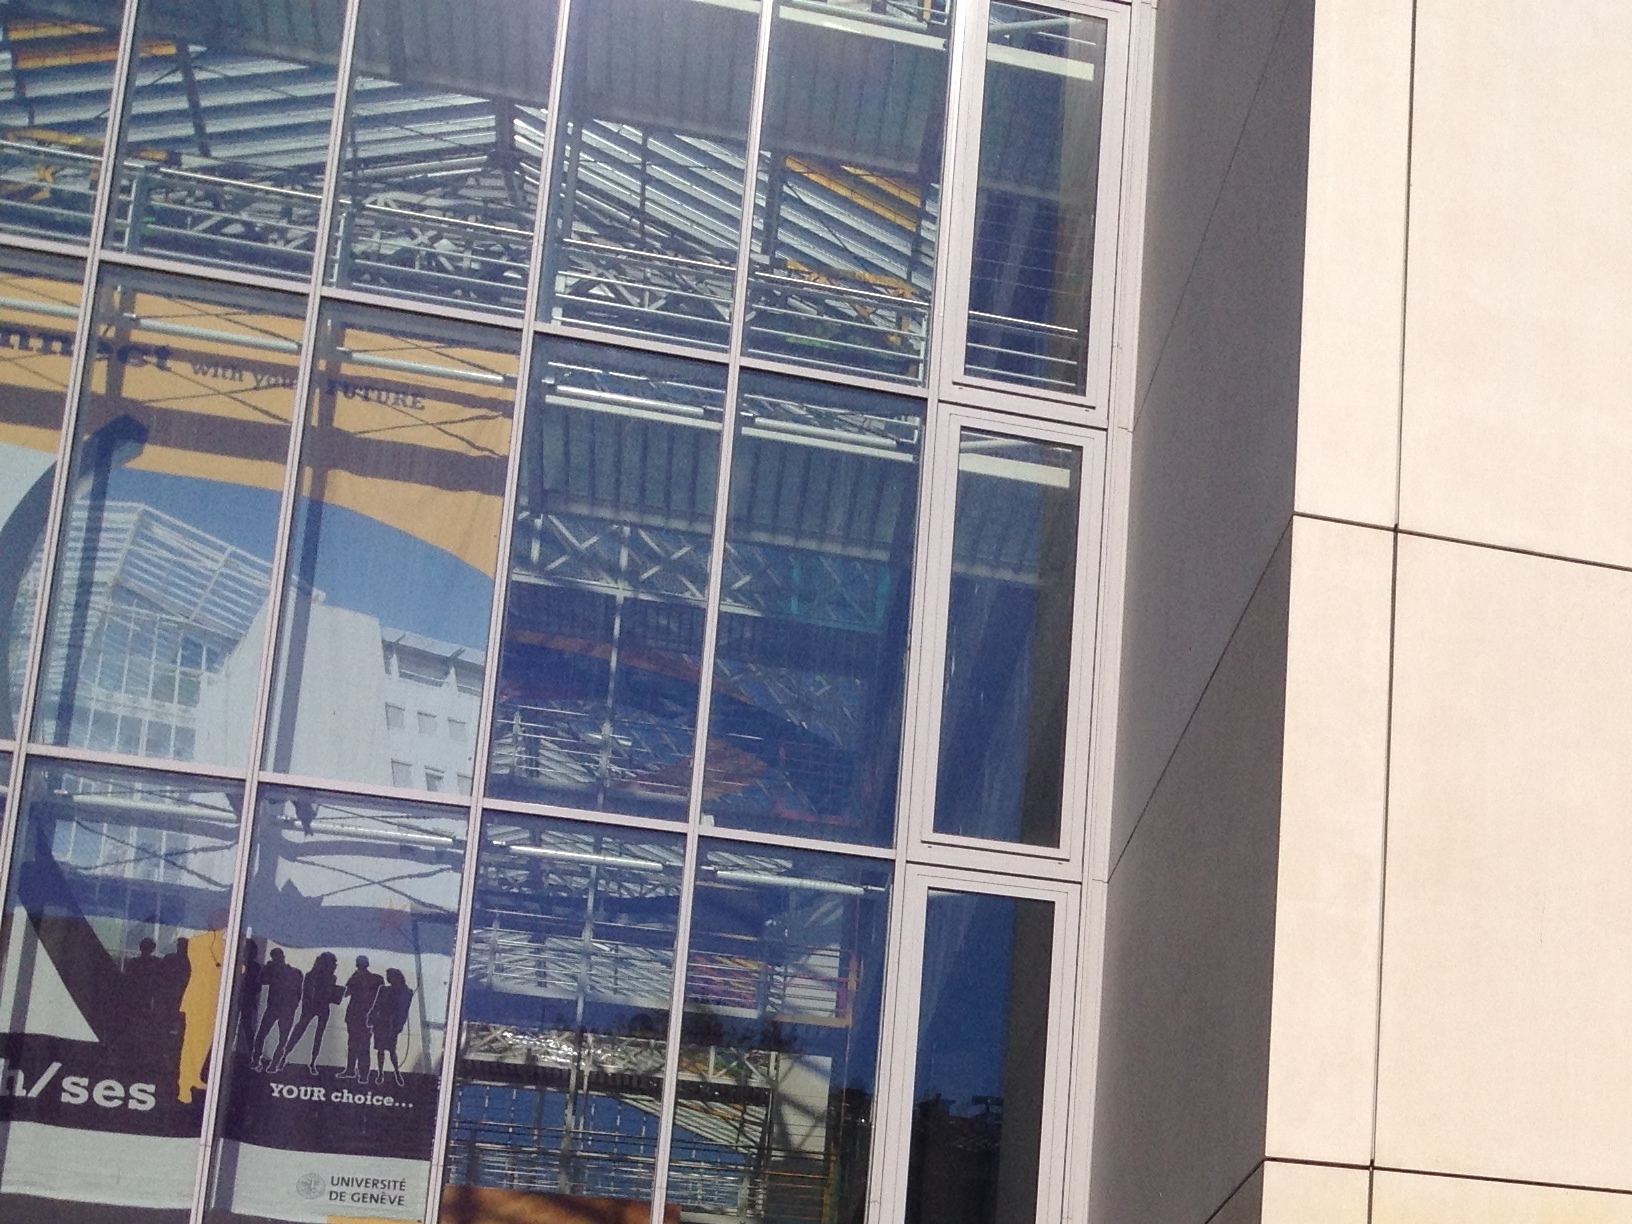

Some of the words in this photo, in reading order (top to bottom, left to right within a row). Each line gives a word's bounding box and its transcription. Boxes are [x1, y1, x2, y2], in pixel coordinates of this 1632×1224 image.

[270, 1082, 326, 1101] YOUR
[331, 1089, 414, 1108] choice...
[330, 1175, 407, 1191] UNIVERSITÉ
[329, 1190, 346, 1202] DE
[351, 1191, 405, 1206] GENÈVE
